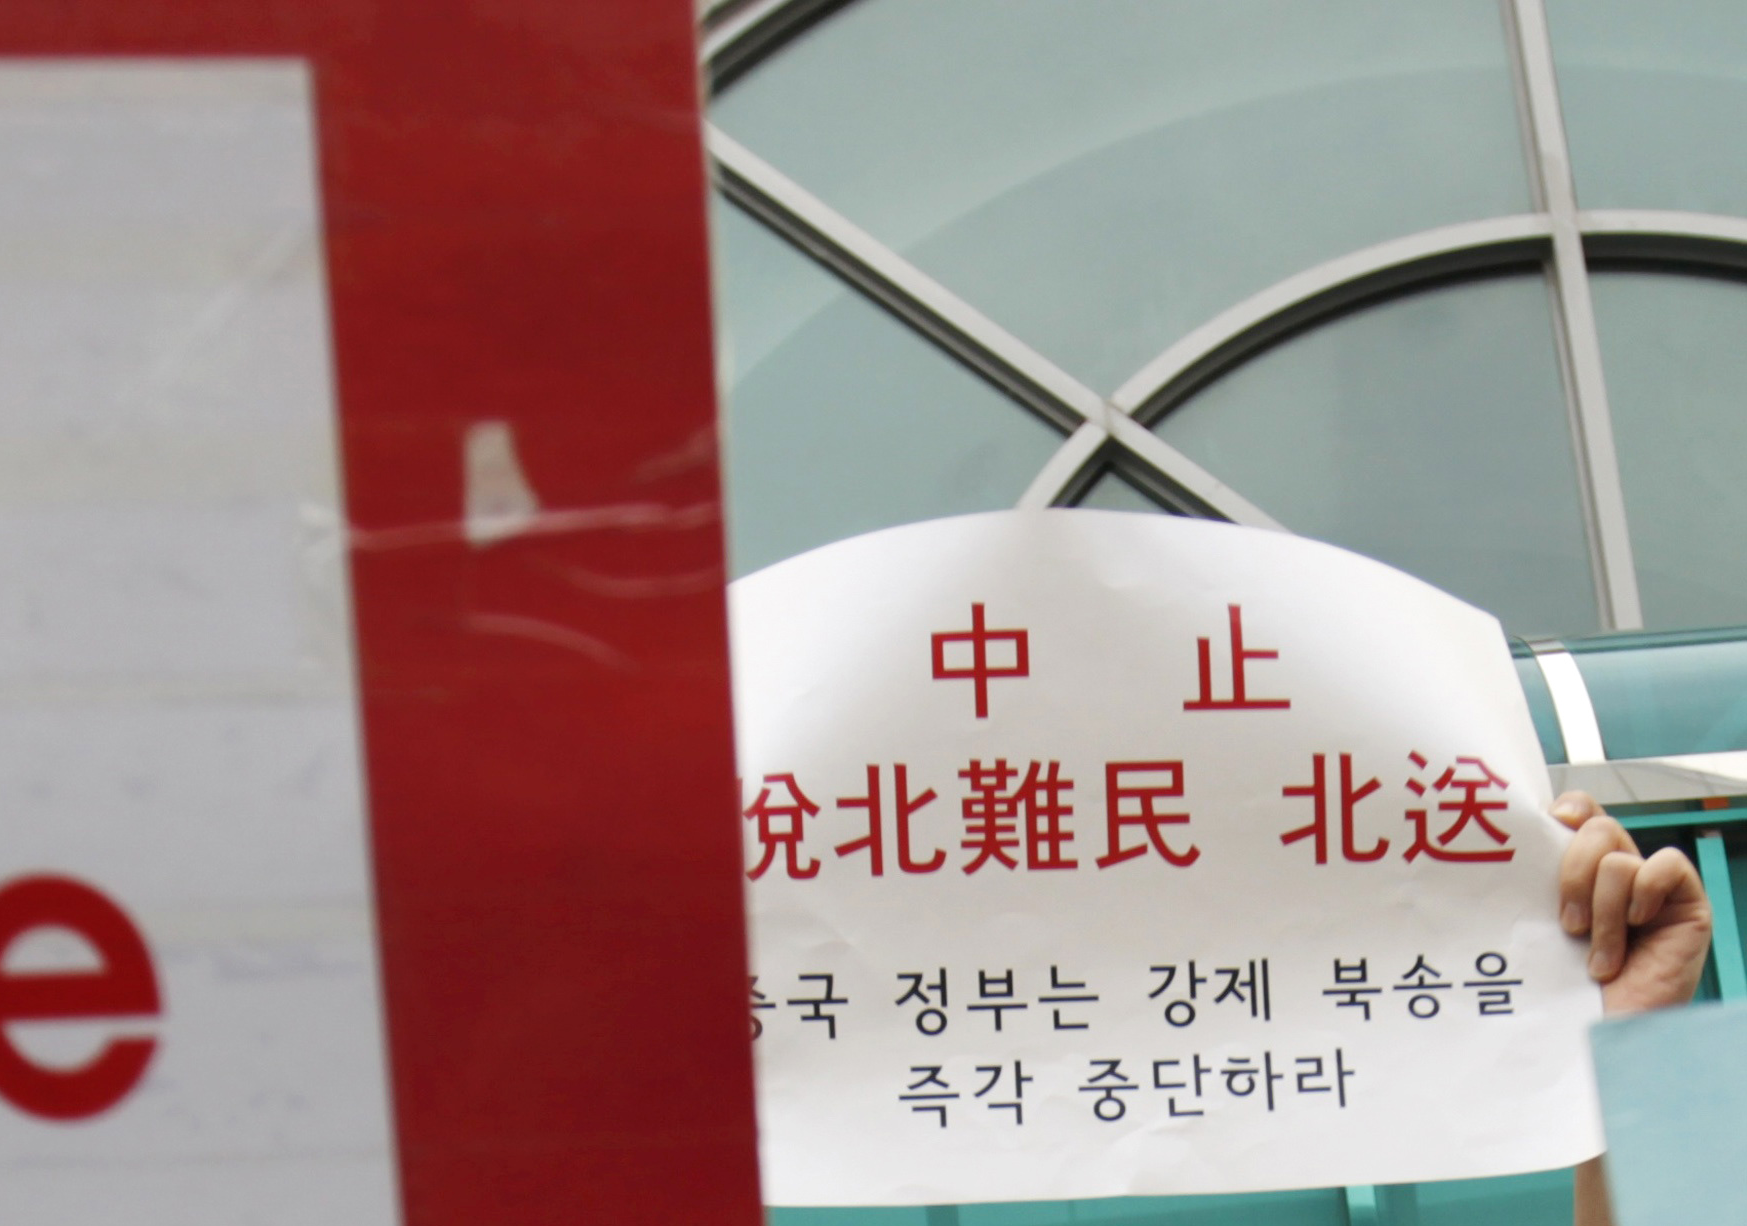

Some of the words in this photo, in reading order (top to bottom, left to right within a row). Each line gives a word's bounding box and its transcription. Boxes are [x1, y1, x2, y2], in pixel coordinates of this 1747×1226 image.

[1281, 751, 1516, 865] 北送
[894, 965, 1099, 1036] 정부는
[1148, 958, 1271, 1027] 강제
[1322, 952, 1524, 1021] 북송을
[898, 1060, 1033, 1128] 즉각
[1078, 1048, 1355, 1121] 중단하라
